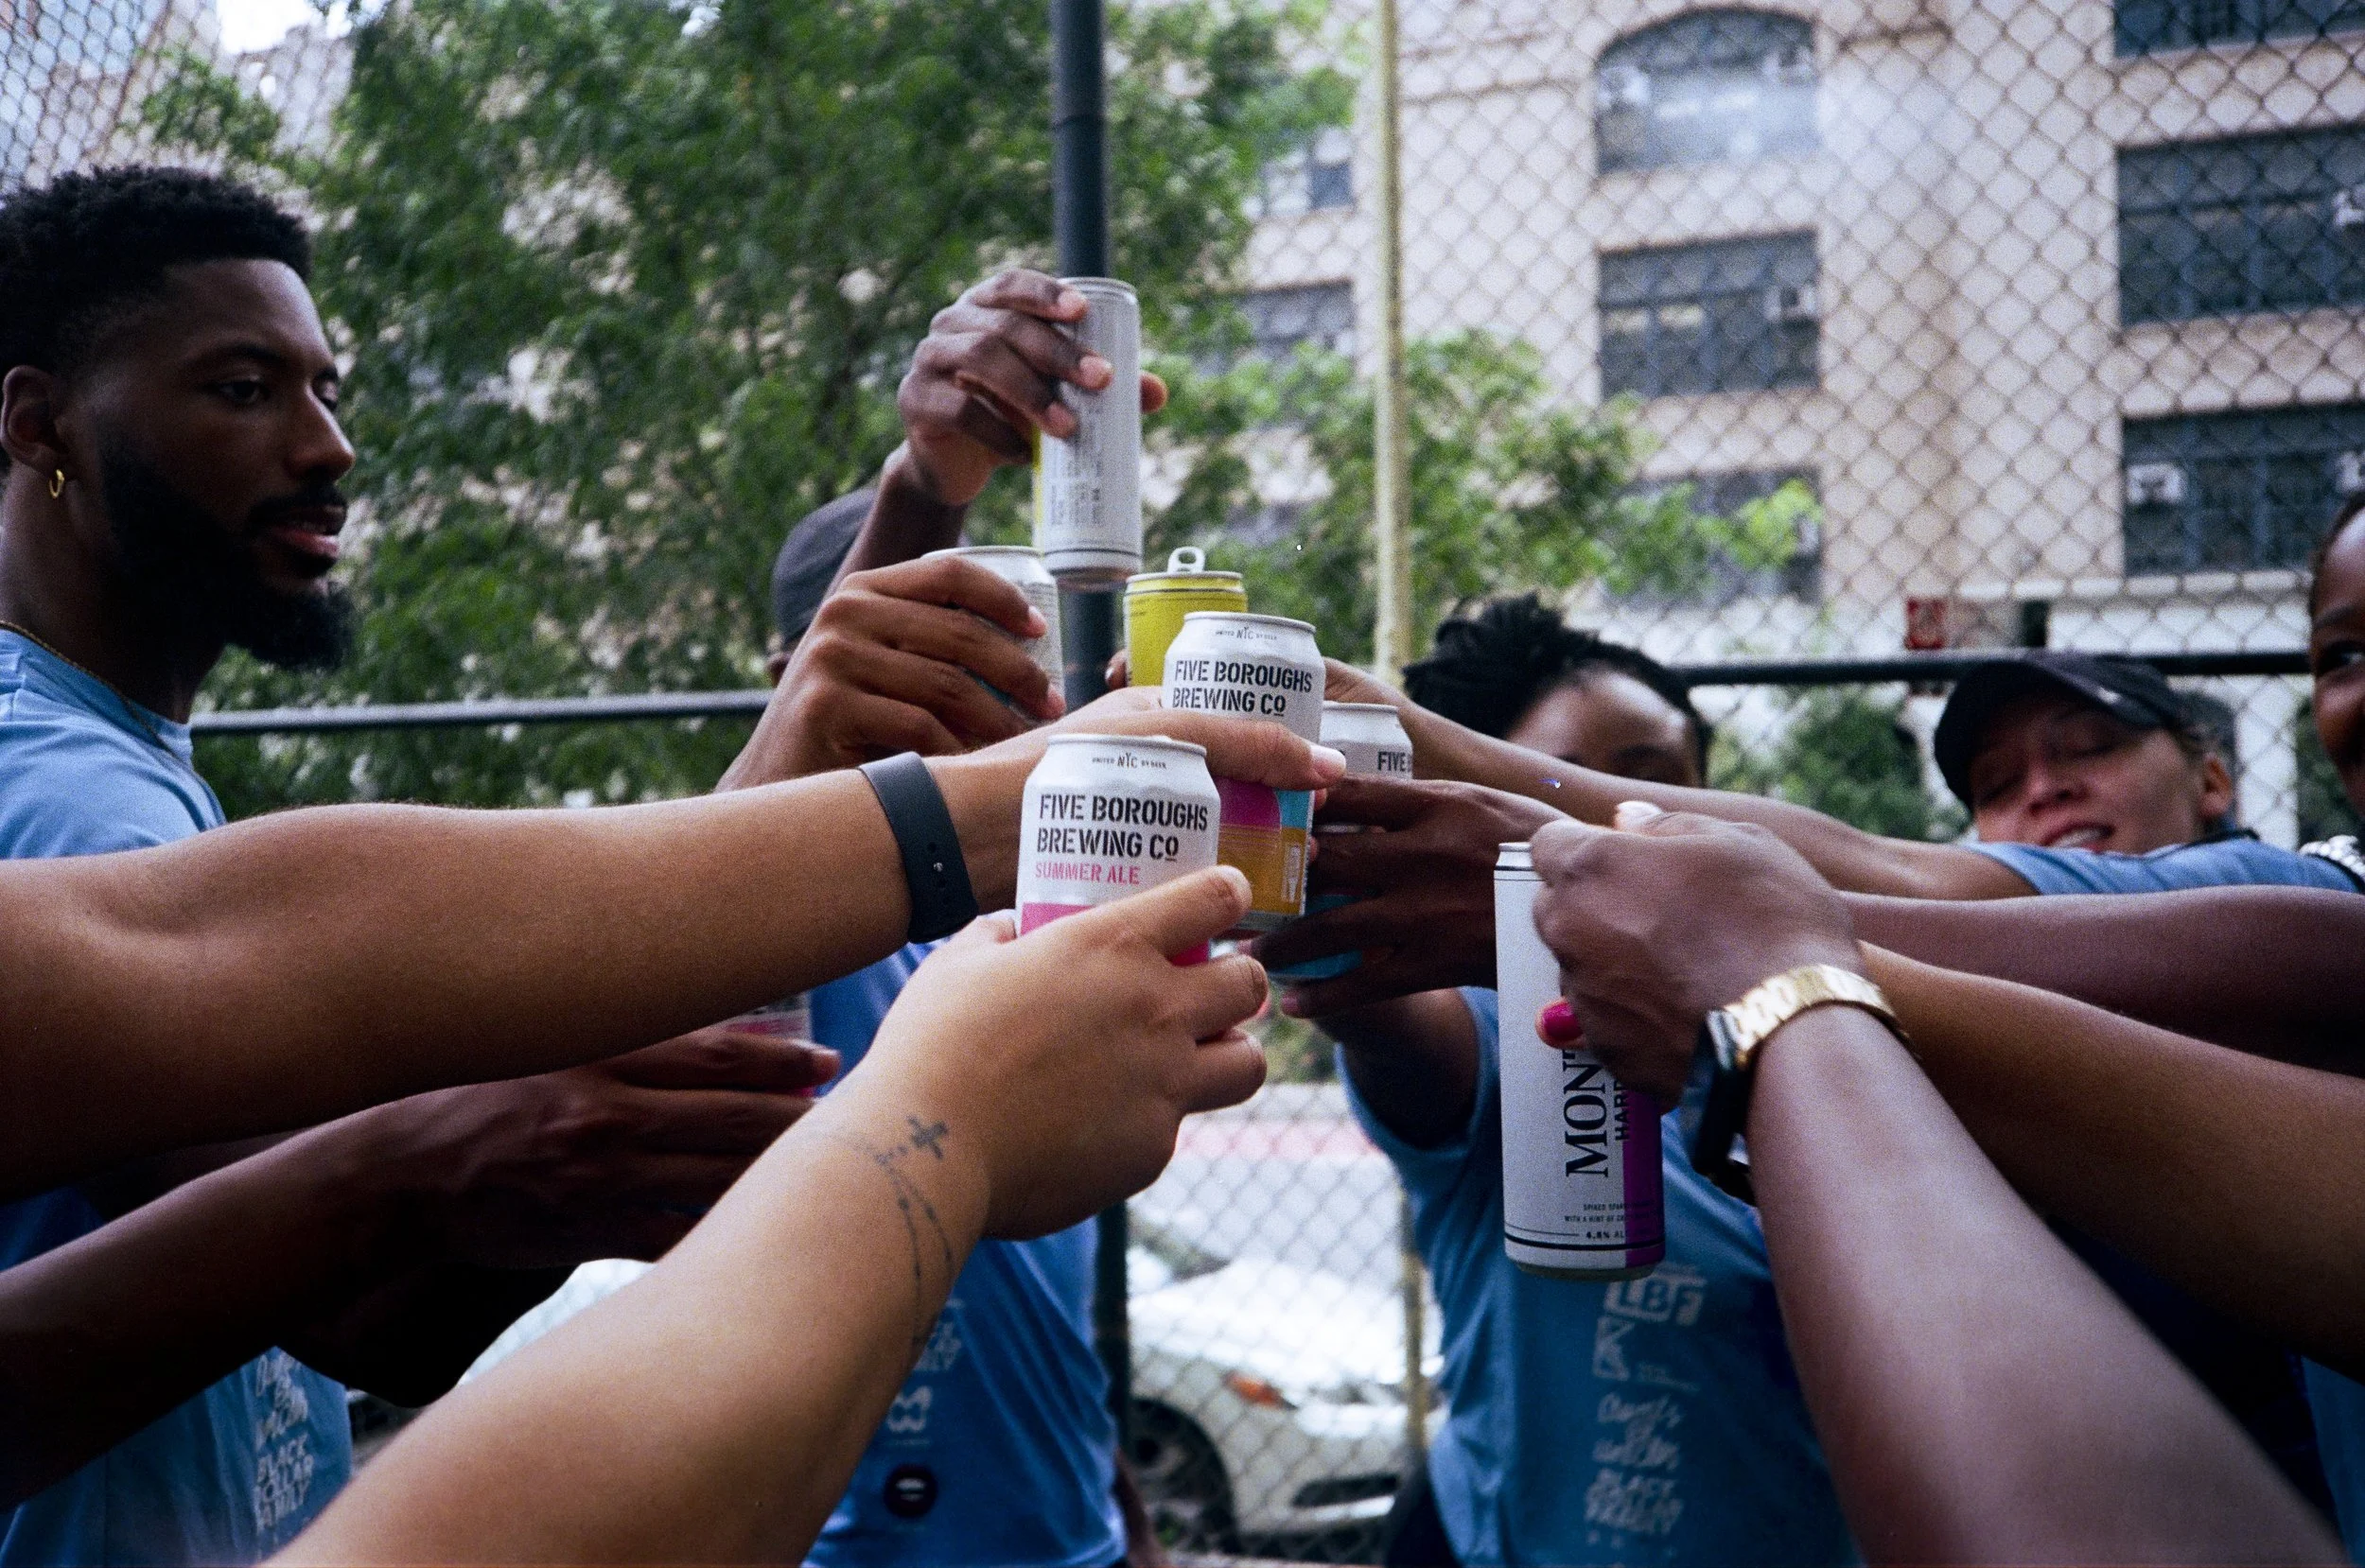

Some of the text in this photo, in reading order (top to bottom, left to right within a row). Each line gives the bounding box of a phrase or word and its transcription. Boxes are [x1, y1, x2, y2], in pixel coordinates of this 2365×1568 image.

[1236, 626, 1253, 639] NYC
[1175, 660, 1313, 693] FIVE BOROUGHS
[1172, 688, 1254, 712] BREWING
[1117, 752, 1138, 769] NYC
[1377, 751, 1406, 772] FIVE
[1040, 793, 1209, 831] FIVE BOROUGHS
[1037, 828, 1143, 858] BREWING
[1035, 862, 1141, 885] SUMMER ALE
